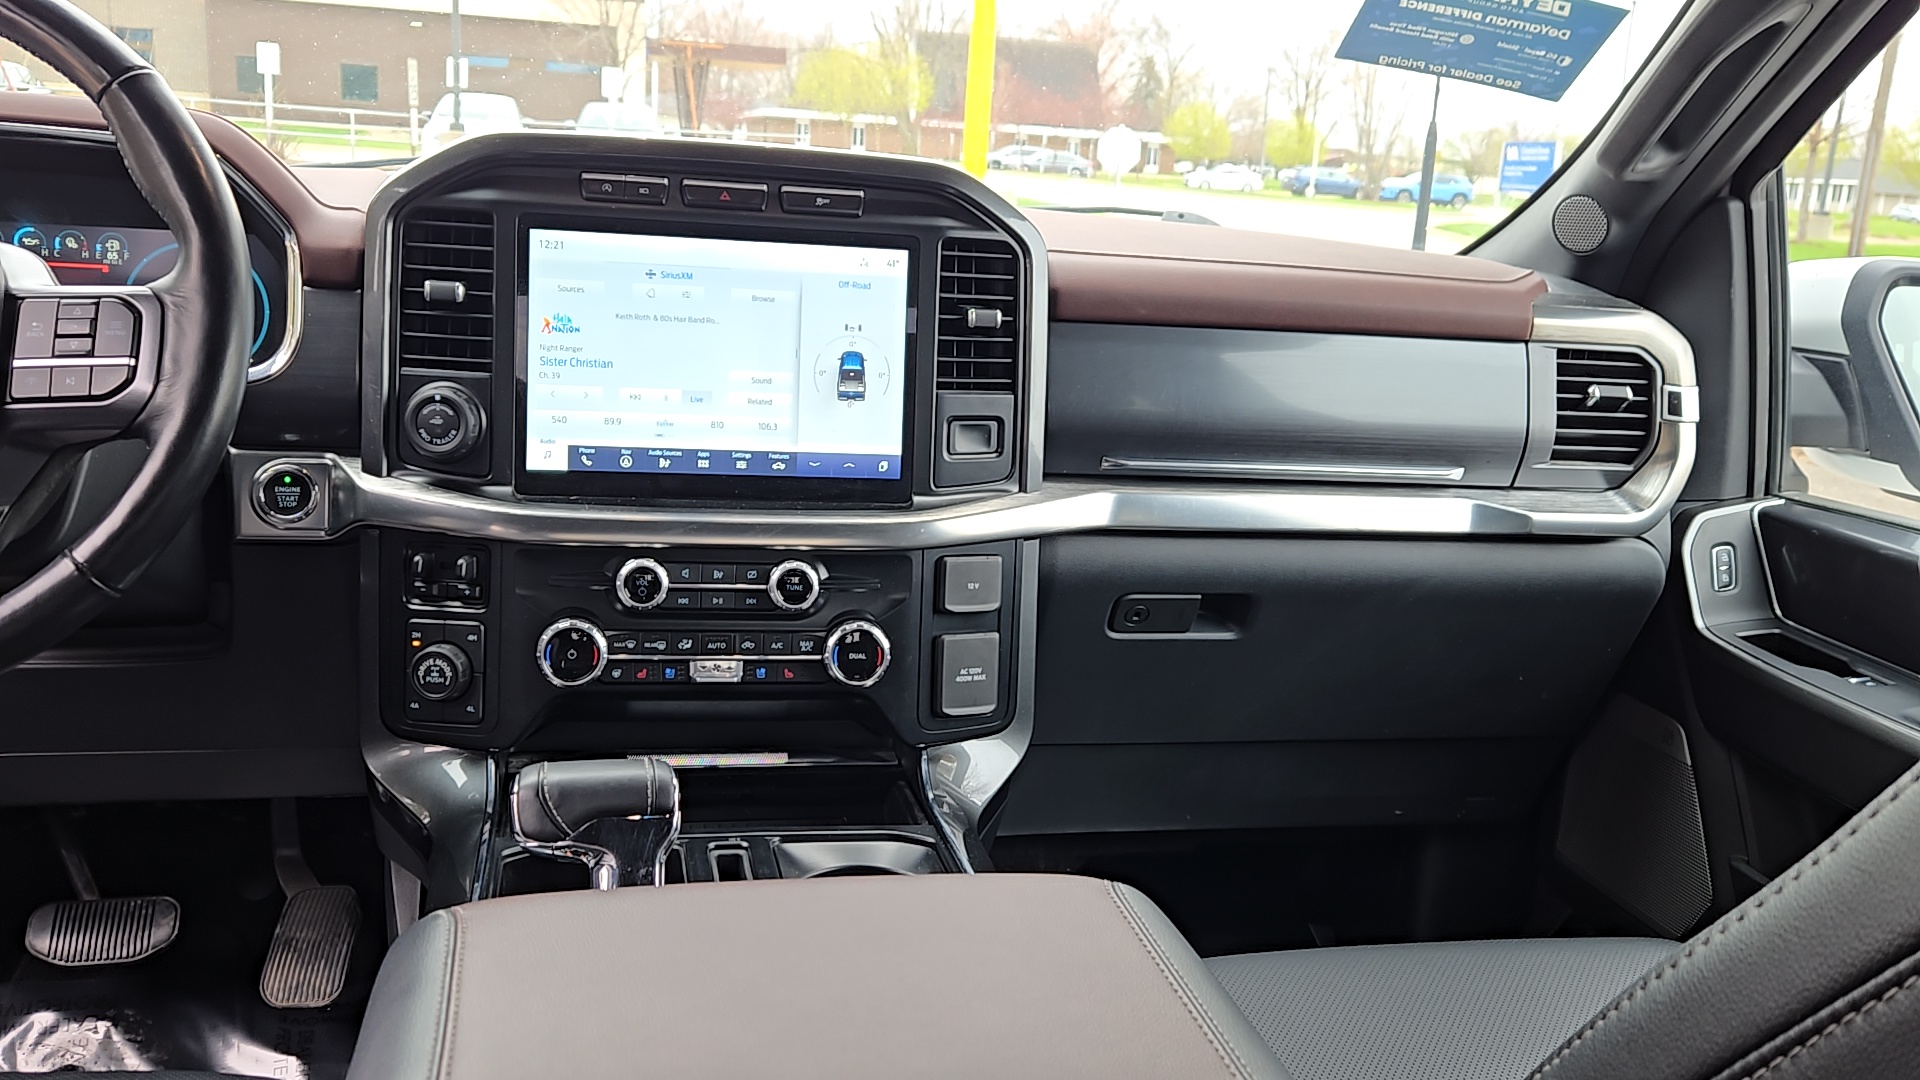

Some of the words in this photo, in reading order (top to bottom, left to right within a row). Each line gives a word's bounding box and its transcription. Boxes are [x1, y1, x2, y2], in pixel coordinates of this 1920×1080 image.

[539, 239, 564, 250] 12:21
[41, 248, 49, 256] H
[96, 251, 102, 259] E
[106, 252, 118, 260] 65
[660, 271, 693, 280] SiriusXM
[557, 284, 585, 293] Sources
[838, 280, 871, 290] Off-Road
[615, 312, 633, 321] Keith
[634, 313, 650, 321] Roth
[688, 316, 705, 324] Band
[540, 344, 558, 352] Night
[559, 345, 583, 353] Ranger
[540, 356, 567, 367] Sister
[570, 357, 613, 369] Christian
[552, 416, 567, 424] 540
[604, 417, 621, 426] 89.9
[710, 421, 724, 429] 810
[758, 422, 778, 431] 106.3
[418, 658, 434, 676] DRIVE
[435, 658, 452, 677] MODE
